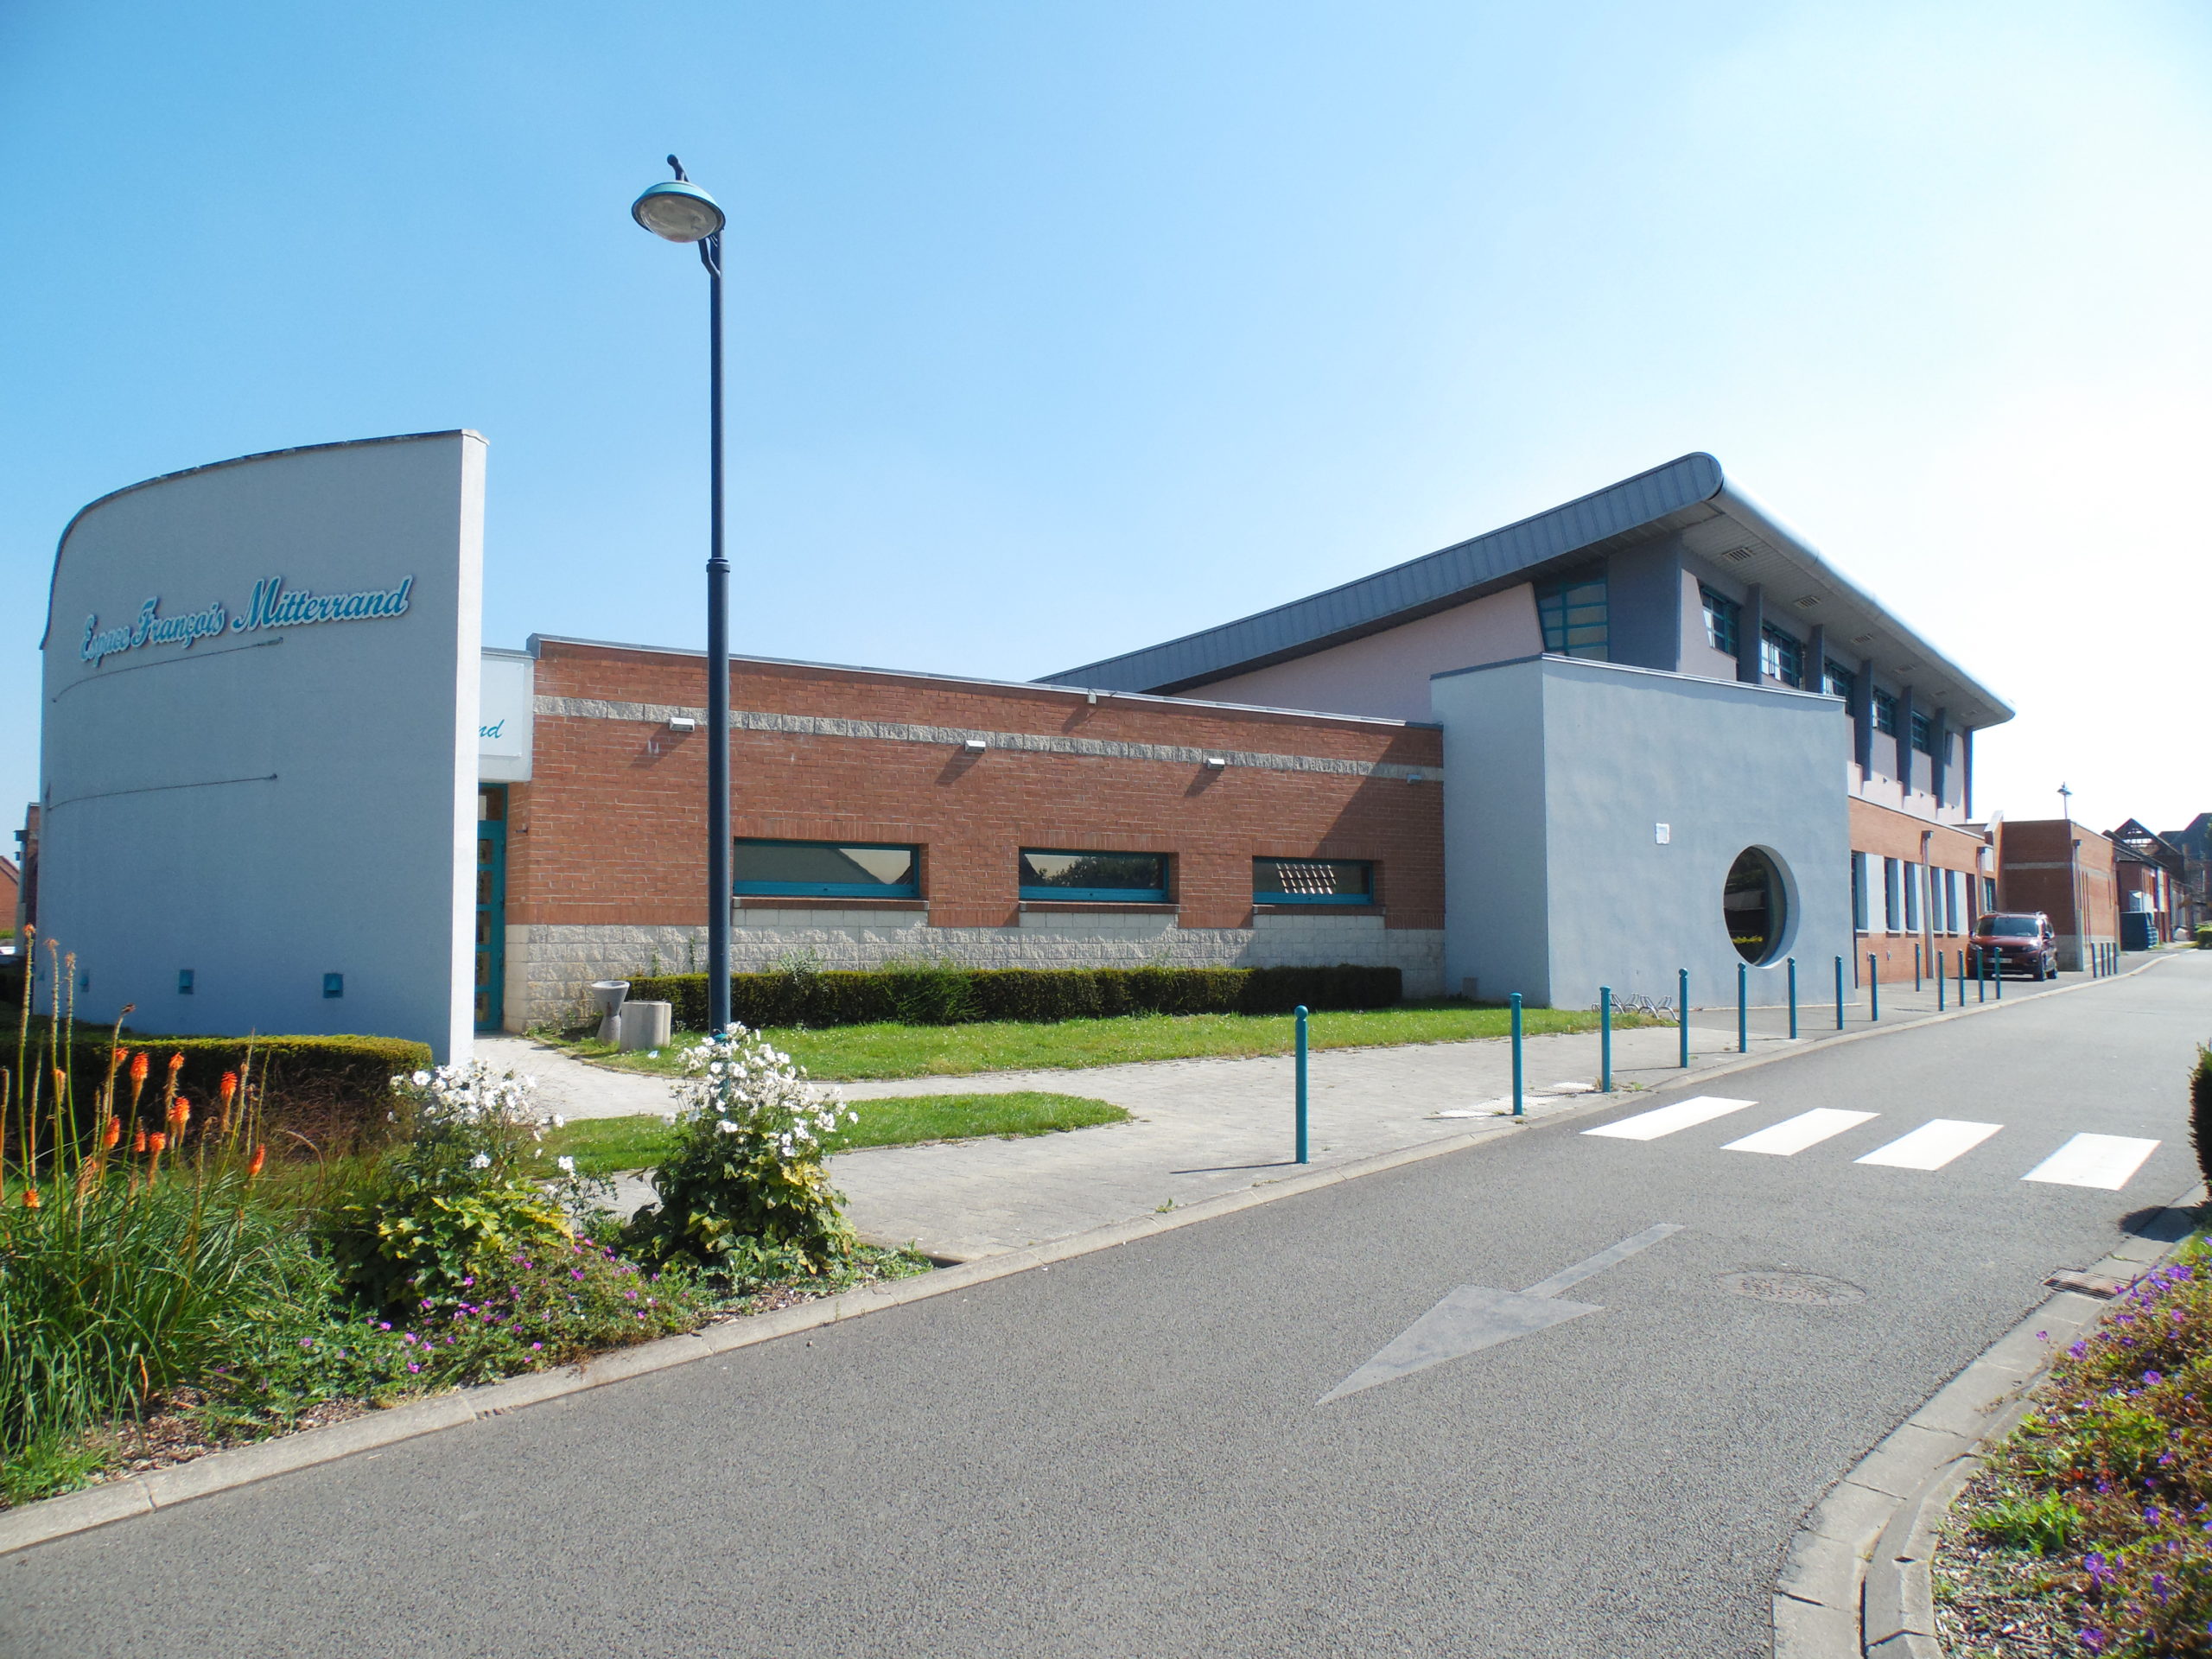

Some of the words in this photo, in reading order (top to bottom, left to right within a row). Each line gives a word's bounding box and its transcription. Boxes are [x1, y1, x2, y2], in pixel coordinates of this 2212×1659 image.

[80, 614, 130, 668] Espace
[131, 596, 225, 648] François
[231, 575, 413, 632] Mitterrand
